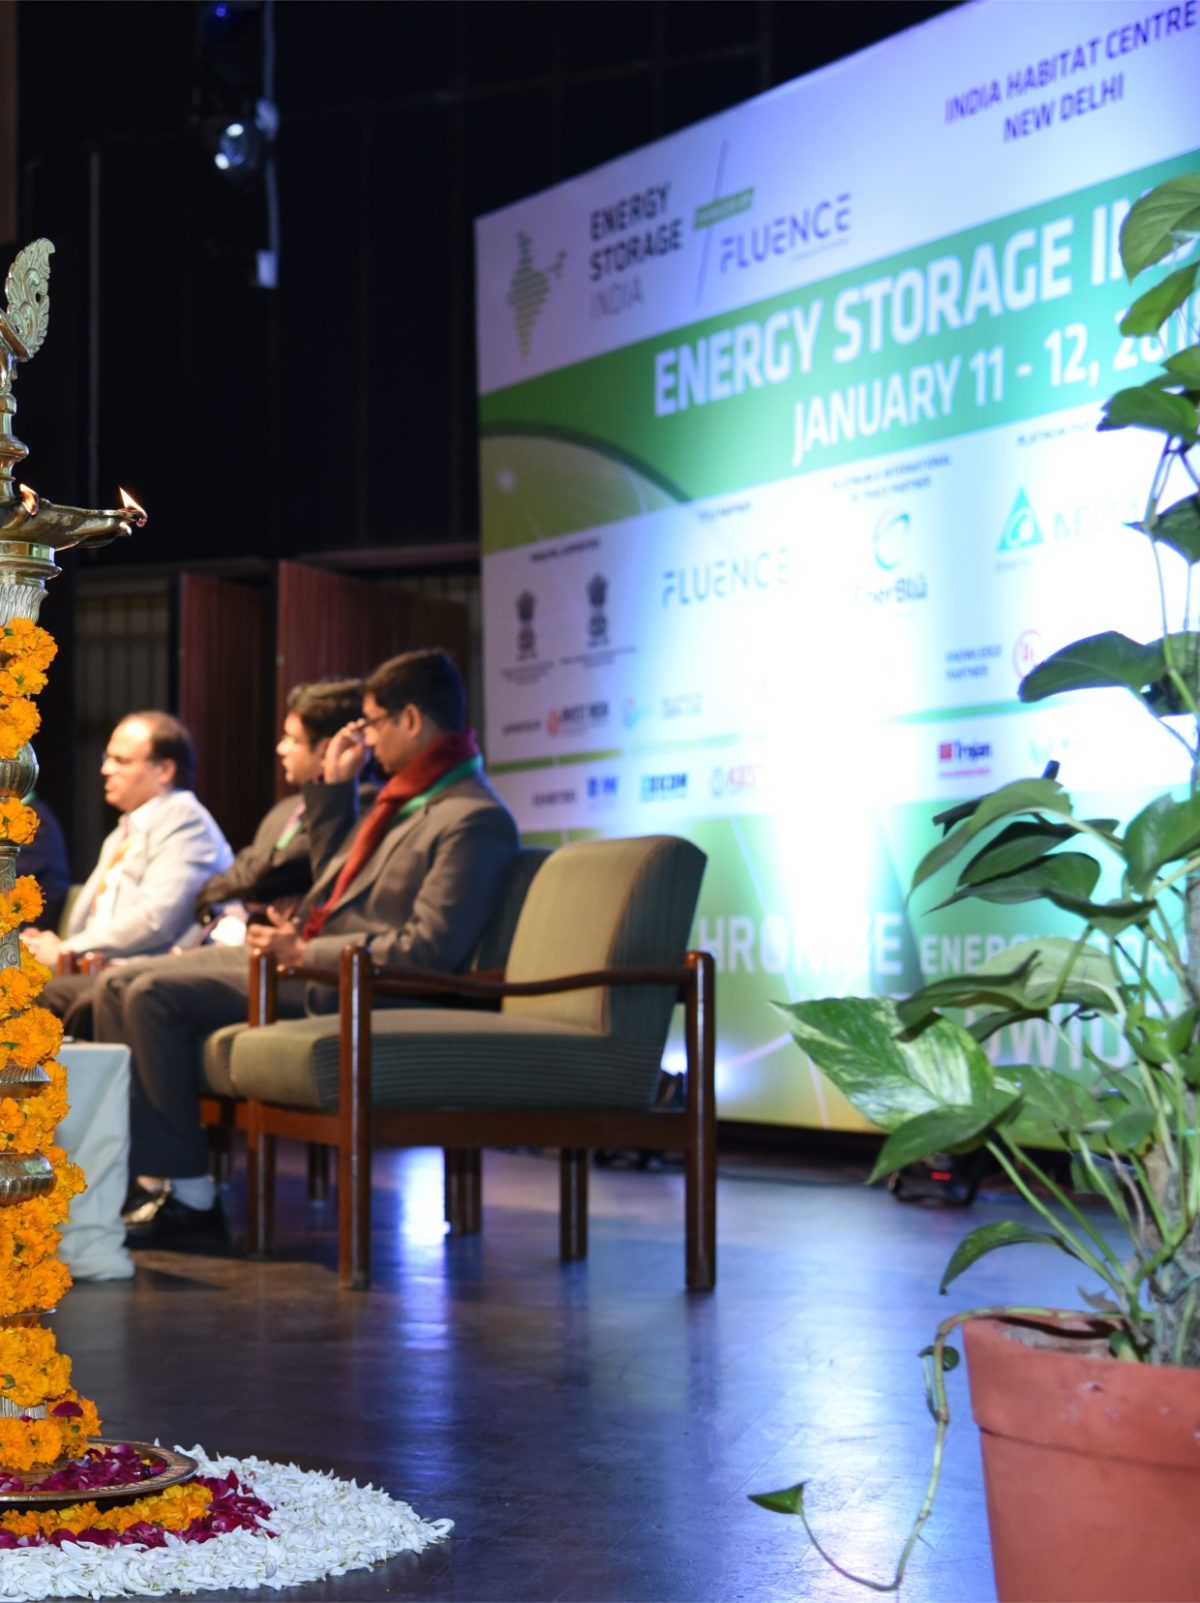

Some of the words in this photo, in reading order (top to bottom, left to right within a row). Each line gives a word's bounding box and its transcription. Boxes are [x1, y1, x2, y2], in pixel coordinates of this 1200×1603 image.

[945, 77, 1002, 126] INDIA
[1006, 35, 1102, 101] HABITAT
[1105, 0, 1199, 60] CENTRE
[1003, 99, 1055, 144] NEW
[1059, 70, 1125, 122] DELHI
[590, 182, 670, 243] ENERGY
[719, 191, 852, 277] FLUENCE
[590, 217, 683, 283] STORAGE
[592, 274, 644, 321] INDIA
[654, 299, 823, 418] ENERGY
[832, 214, 1074, 363] STORAGE
[792, 353, 962, 468] JANUARY
[968, 344, 1005, 408] 11
[1044, 322, 1100, 390] 12,
[661, 546, 789, 610] FLUENCE
